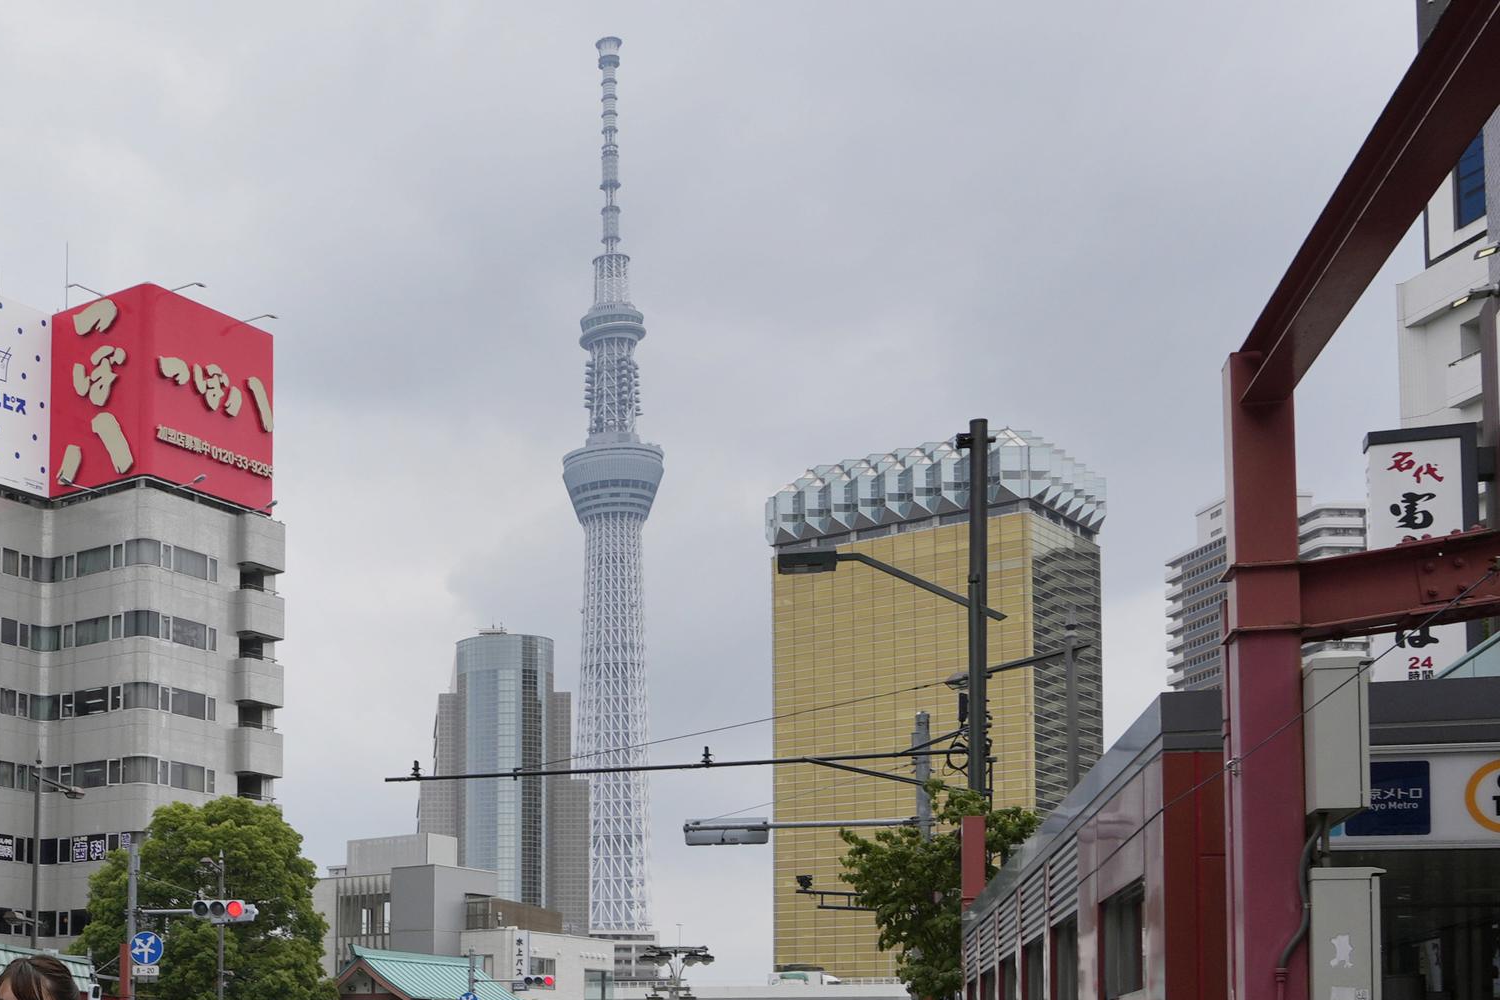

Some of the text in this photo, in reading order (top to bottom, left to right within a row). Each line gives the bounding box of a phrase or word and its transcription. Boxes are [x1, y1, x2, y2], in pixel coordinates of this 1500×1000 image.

[56, 299, 135, 487] つぼ八
[157, 355, 274, 434] つぼ八
[156, 424, 211, 457] 加盟店募集中
[1387, 451, 1445, 484] 名代
[1408, 656, 1434, 669] 24
[1388, 800, 1419, 810] Metro
[72, 839, 106, 862] 歯科
[515, 937, 524, 977] 水上バス
